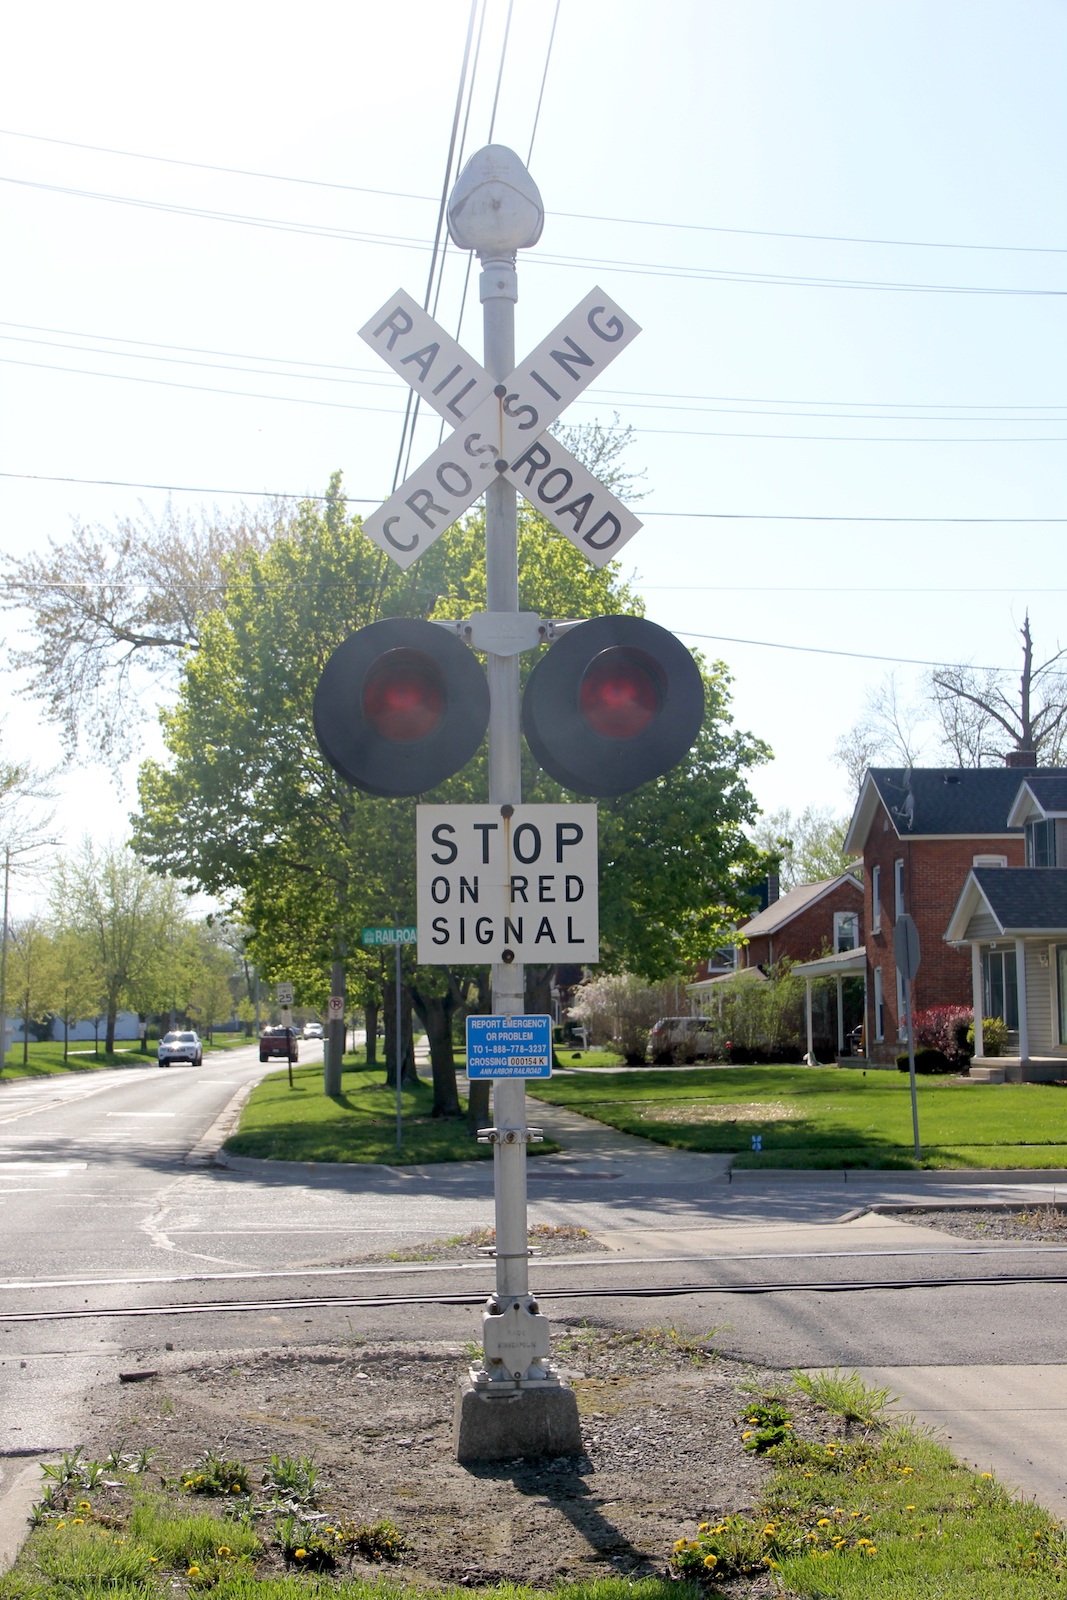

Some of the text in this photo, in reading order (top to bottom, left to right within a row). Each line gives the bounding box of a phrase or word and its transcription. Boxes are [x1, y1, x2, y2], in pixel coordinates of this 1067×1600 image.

[431, 822, 584, 865] STOP
[431, 875, 584, 904] ON RED
[375, 929, 417, 942] RAILROA
[431, 916, 585, 945] SIGNAL
[278, 993, 292, 1003] 25
[471, 1019, 547, 1029] REPORT EMERGENCY
[486, 1032, 534, 1041] OR PROBLEM
[472, 1045, 484, 1053] TO
[469, 1057, 507, 1066] CROSSING
[539, 1057, 545, 1065] K
